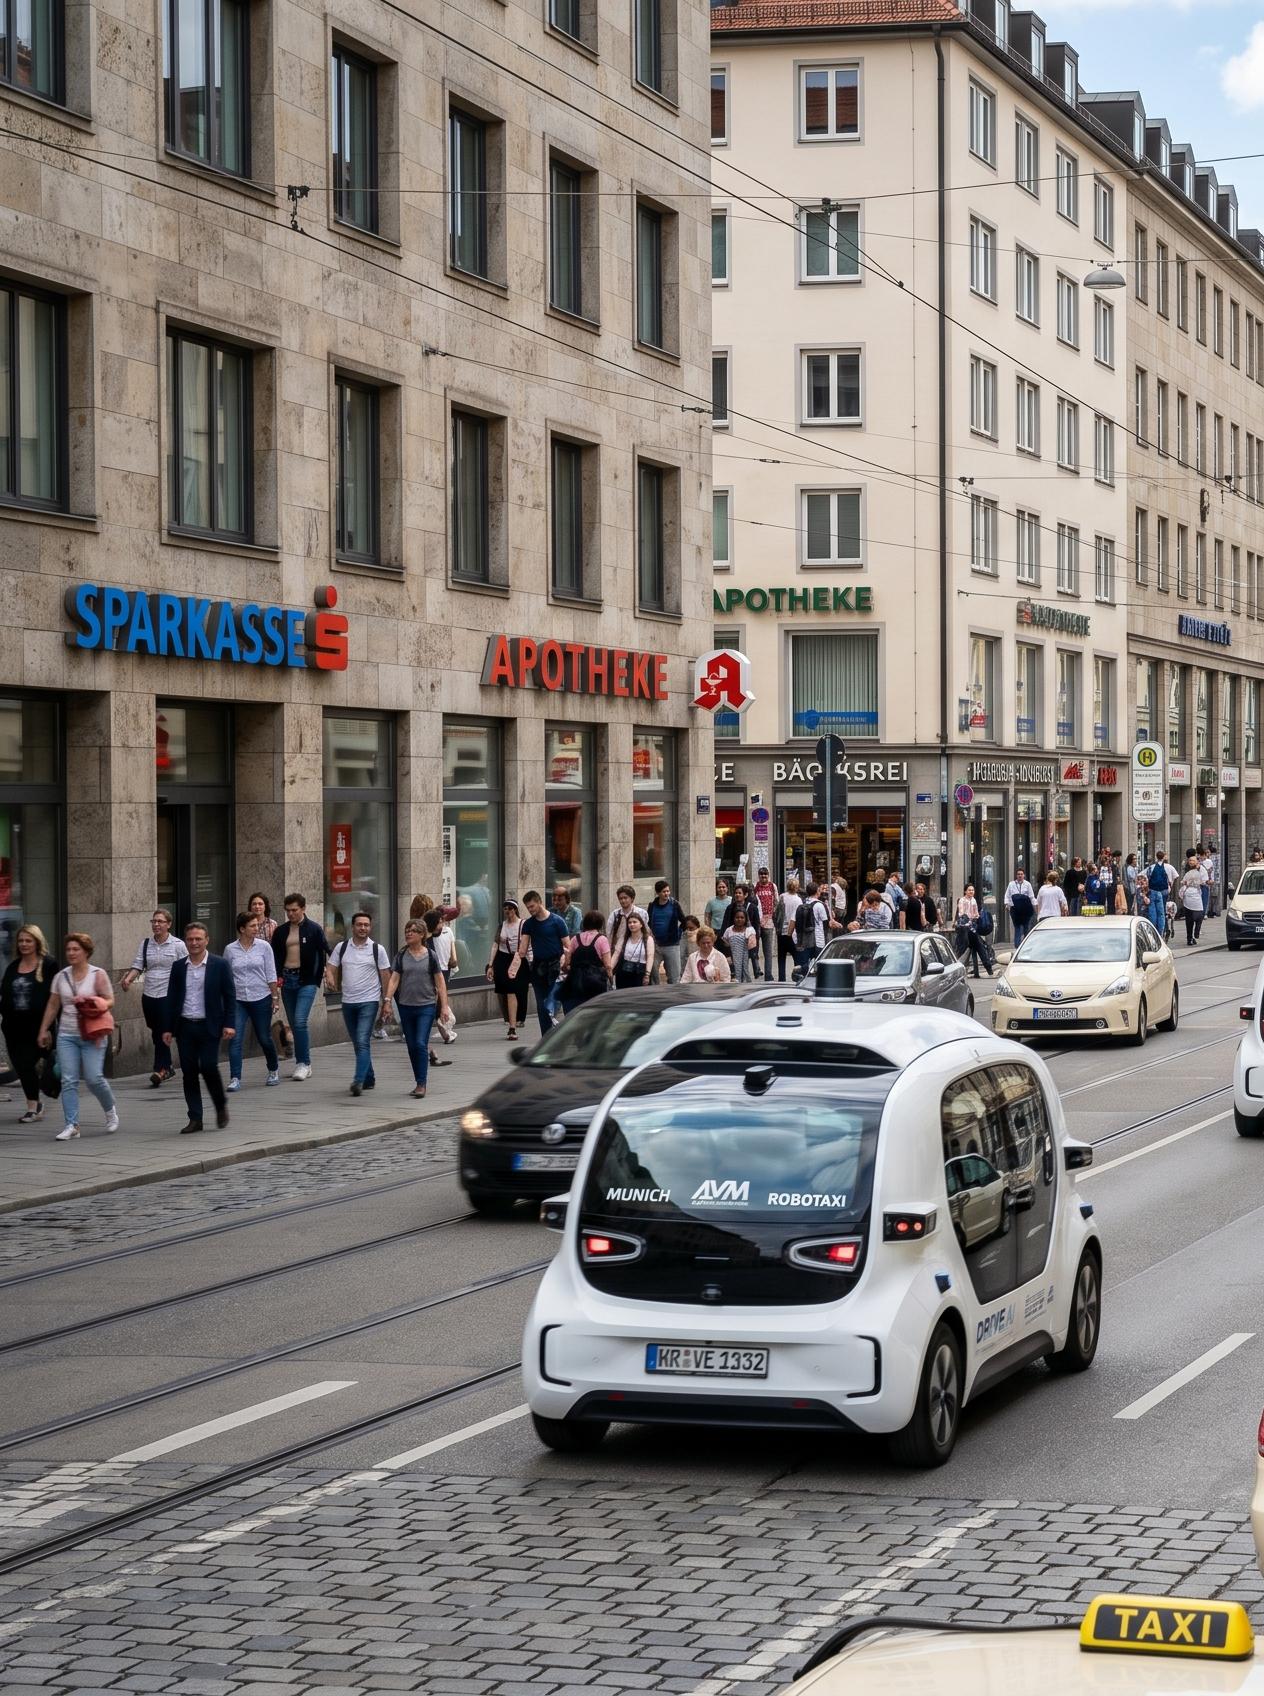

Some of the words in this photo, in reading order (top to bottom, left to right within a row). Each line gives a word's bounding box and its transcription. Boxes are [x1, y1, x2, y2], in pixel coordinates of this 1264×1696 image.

[75, 583, 306, 668] SPARKASSE
[491, 634, 668, 700] APOTHEKE
[606, 1187, 671, 1203] MUNICH
[691, 1179, 750, 1200] AVM
[767, 1192, 847, 1208] ROBOTAXI
[693, 1350, 715, 1369] VE
[719, 1351, 765, 1371] 1332
[1114, 1607, 1212, 1644] TAXI
